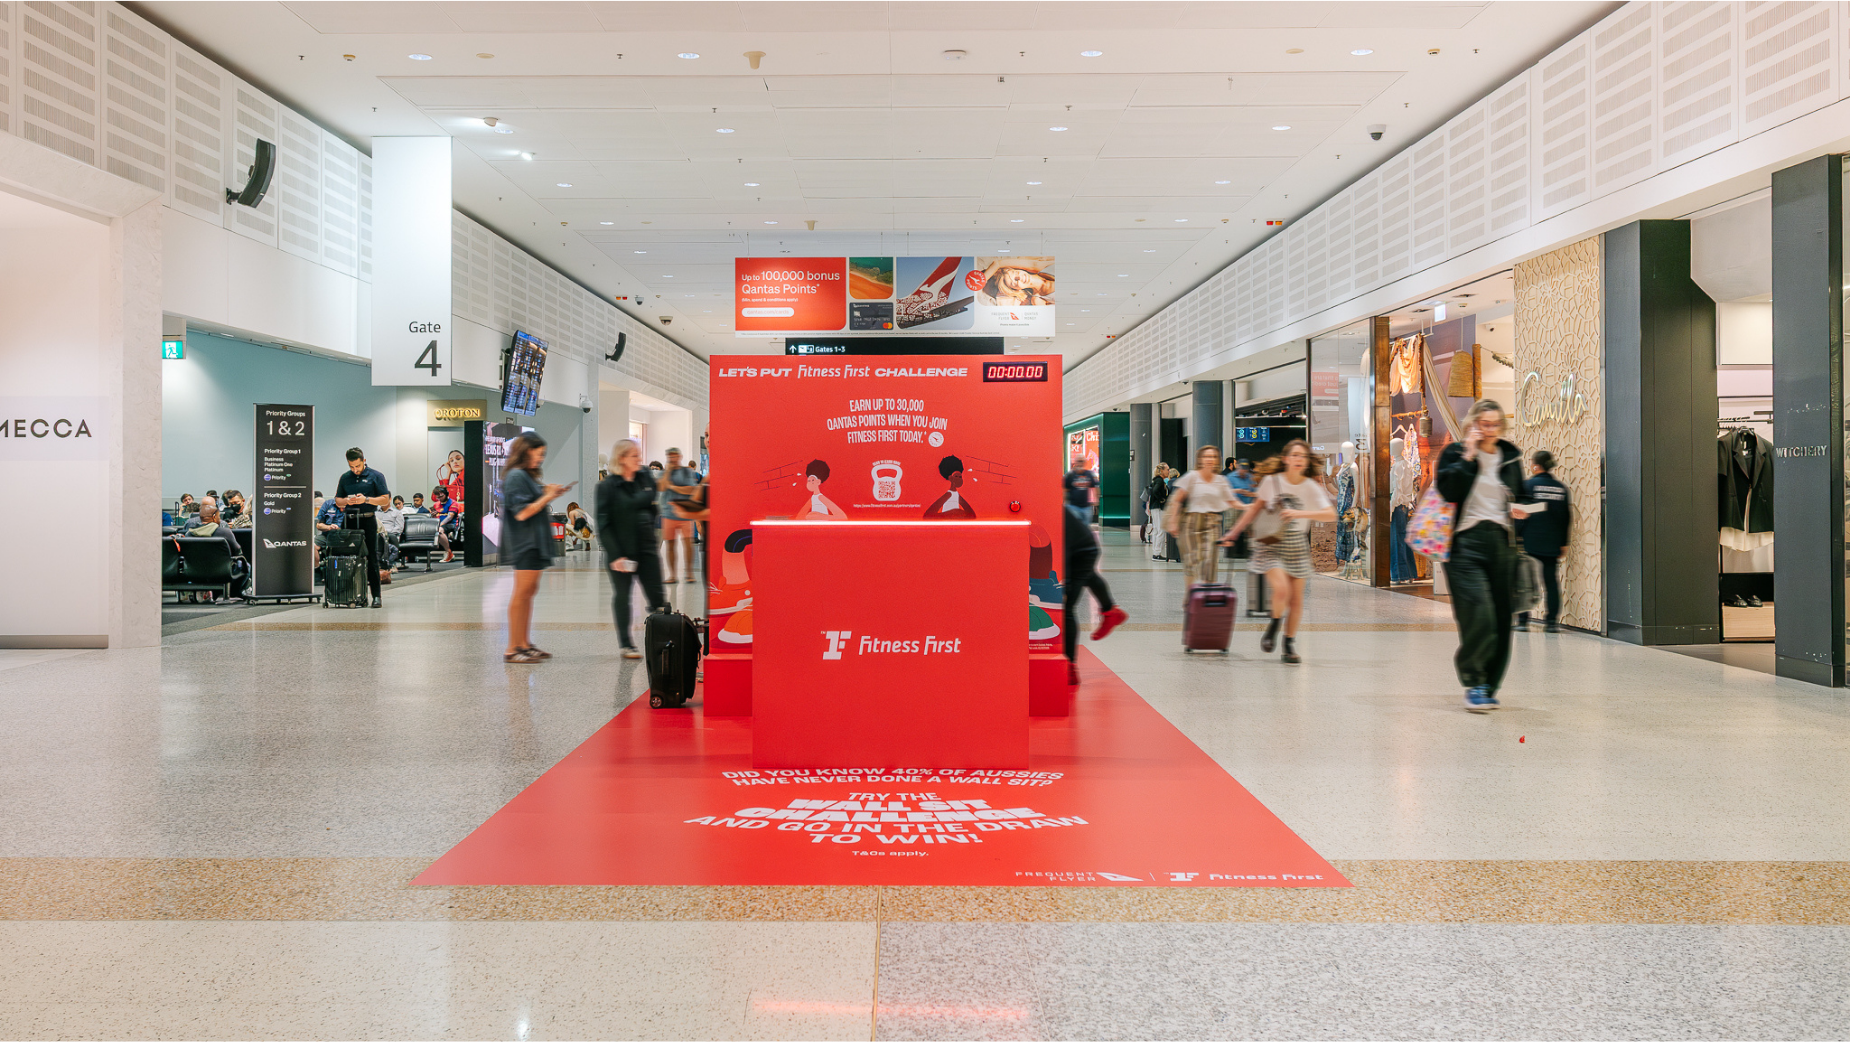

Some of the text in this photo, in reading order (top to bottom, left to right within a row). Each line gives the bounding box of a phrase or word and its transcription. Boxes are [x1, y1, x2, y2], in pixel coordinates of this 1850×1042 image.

[742, 274, 752, 282] Up
[761, 270, 805, 282] 100,000
[807, 270, 840, 281] bonus
[742, 284, 780, 295] Qantas
[409, 321, 441, 333] Gate
[414, 340, 442, 377] 4
[719, 364, 968, 378] LET'S PUT Fitness First CHALLENGE
[850, 398, 924, 412] EARN UP TO 30,000
[1521, 371, 1589, 427] Camilla
[434, 408, 481, 418] OROTON
[266, 420, 305, 436] 1 & 2
[826, 414, 948, 430] QANTAS POINTS WHEN YOU JOIN
[847, 430, 876, 444] FITNESS
[878, 430, 898, 442] FIRST
[1776, 446, 1828, 458] WITCHERY
[858, 636, 961, 656] Fitness First
[722, 771, 762, 779] DID
[765, 769, 810, 777] YOU
[970, 769, 1064, 780] AUSSIES
[732, 778, 790, 786] HAVE
[950, 776, 1002, 785] WALL
[1007, 778, 1054, 787] SIT?
[848, 792, 942, 801] TRY THE
[787, 798, 992, 812] WALL SIT
[734, 807, 1046, 822] CHALLENGE
[683, 816, 1090, 834] AND GO IN THE DRAW
[809, 834, 983, 844] TO WIN!
